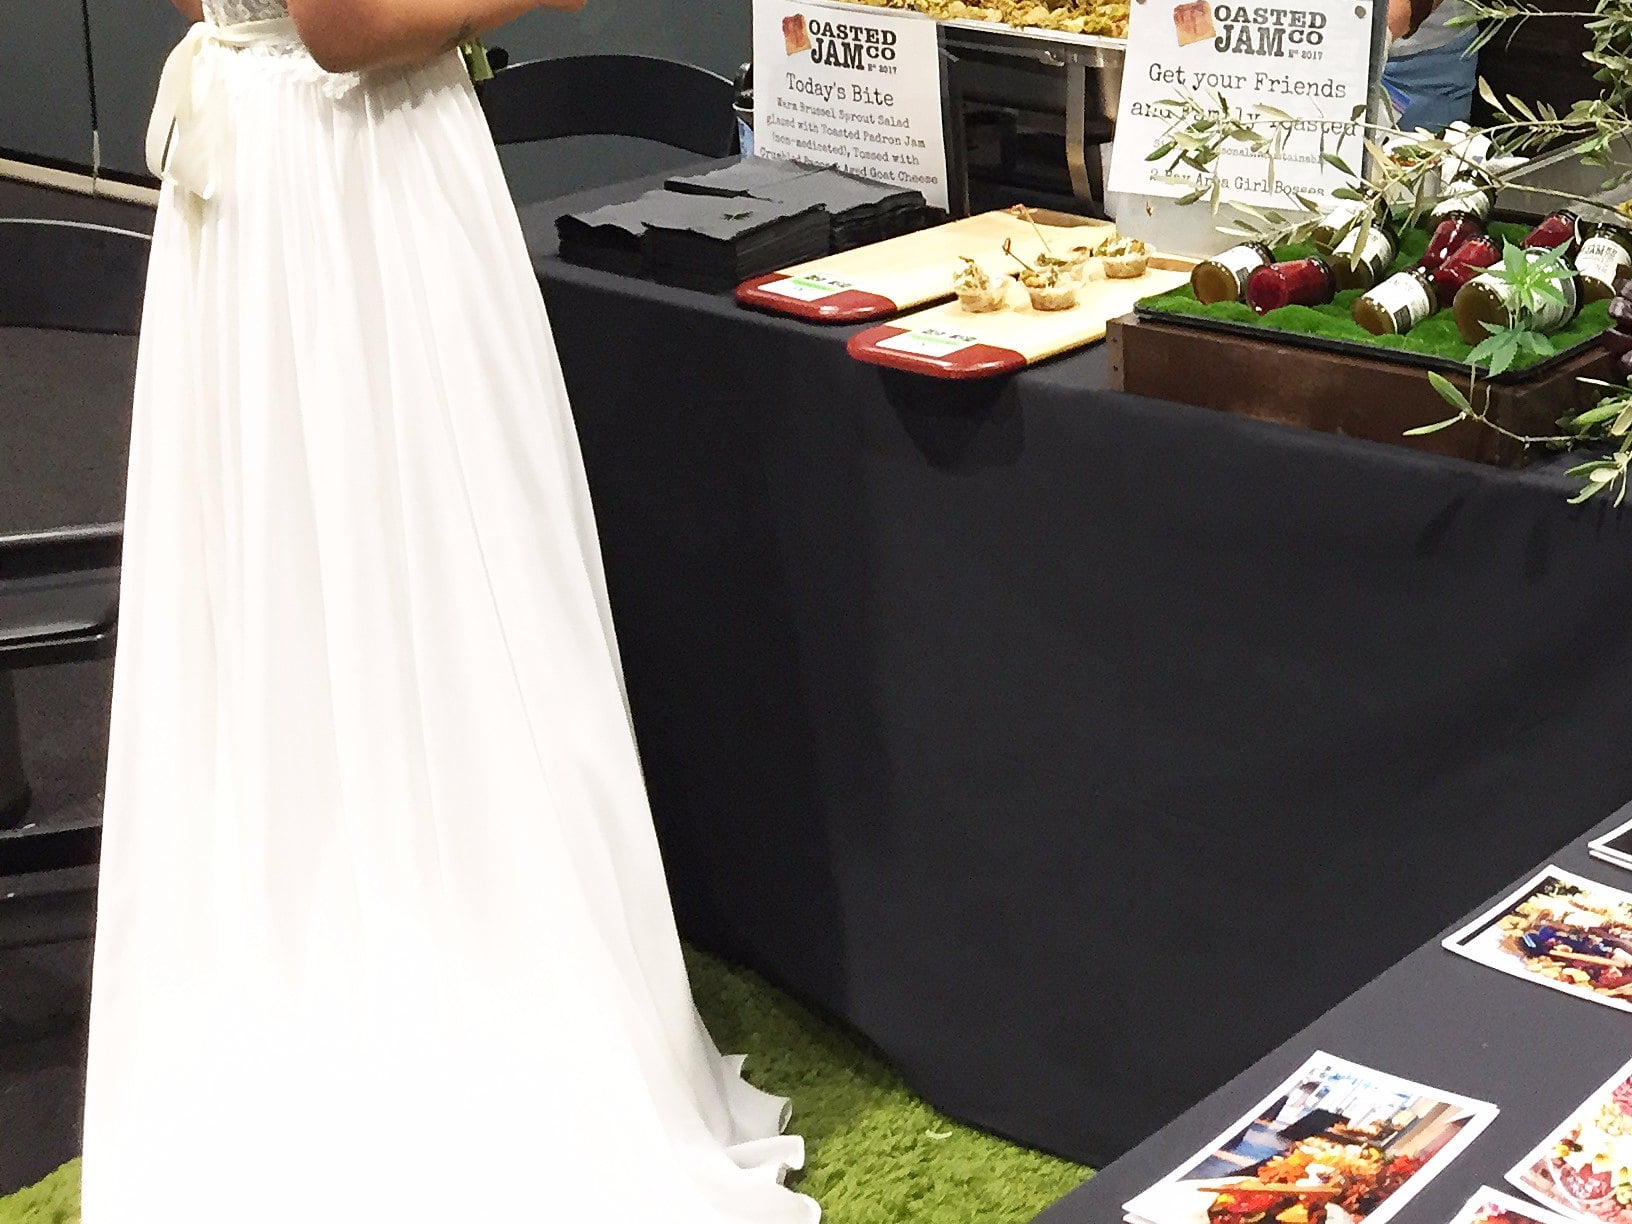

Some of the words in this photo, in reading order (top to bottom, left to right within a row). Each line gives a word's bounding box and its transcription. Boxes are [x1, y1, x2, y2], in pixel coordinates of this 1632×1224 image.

[1214, 24, 1286, 57] JAM
[1288, 29, 1324, 45] CO
[810, 38, 865, 70] JAM
[866, 45, 896, 60] CO
[1301, 50, 1323, 60] 2017
[879, 64, 897, 74] 2017
[786, 72, 846, 102] Today's
[852, 84, 894, 106] Bite
[1149, 63, 1186, 86] Get
[1192, 71, 1247, 92] your
[1254, 72, 1346, 98] Friends
[839, 109, 876, 125] Sprout
[878, 115, 910, 128] Salad
[797, 121, 819, 134] with
[820, 123, 861, 140] Toasted
[904, 136, 926, 148] Jam
[853, 147, 889, 162] Tossed
[892, 154, 920, 165] with
[870, 167, 896, 181] Goat
[897, 170, 938, 185] Cheese
[1234, 176, 1270, 193] Girl
